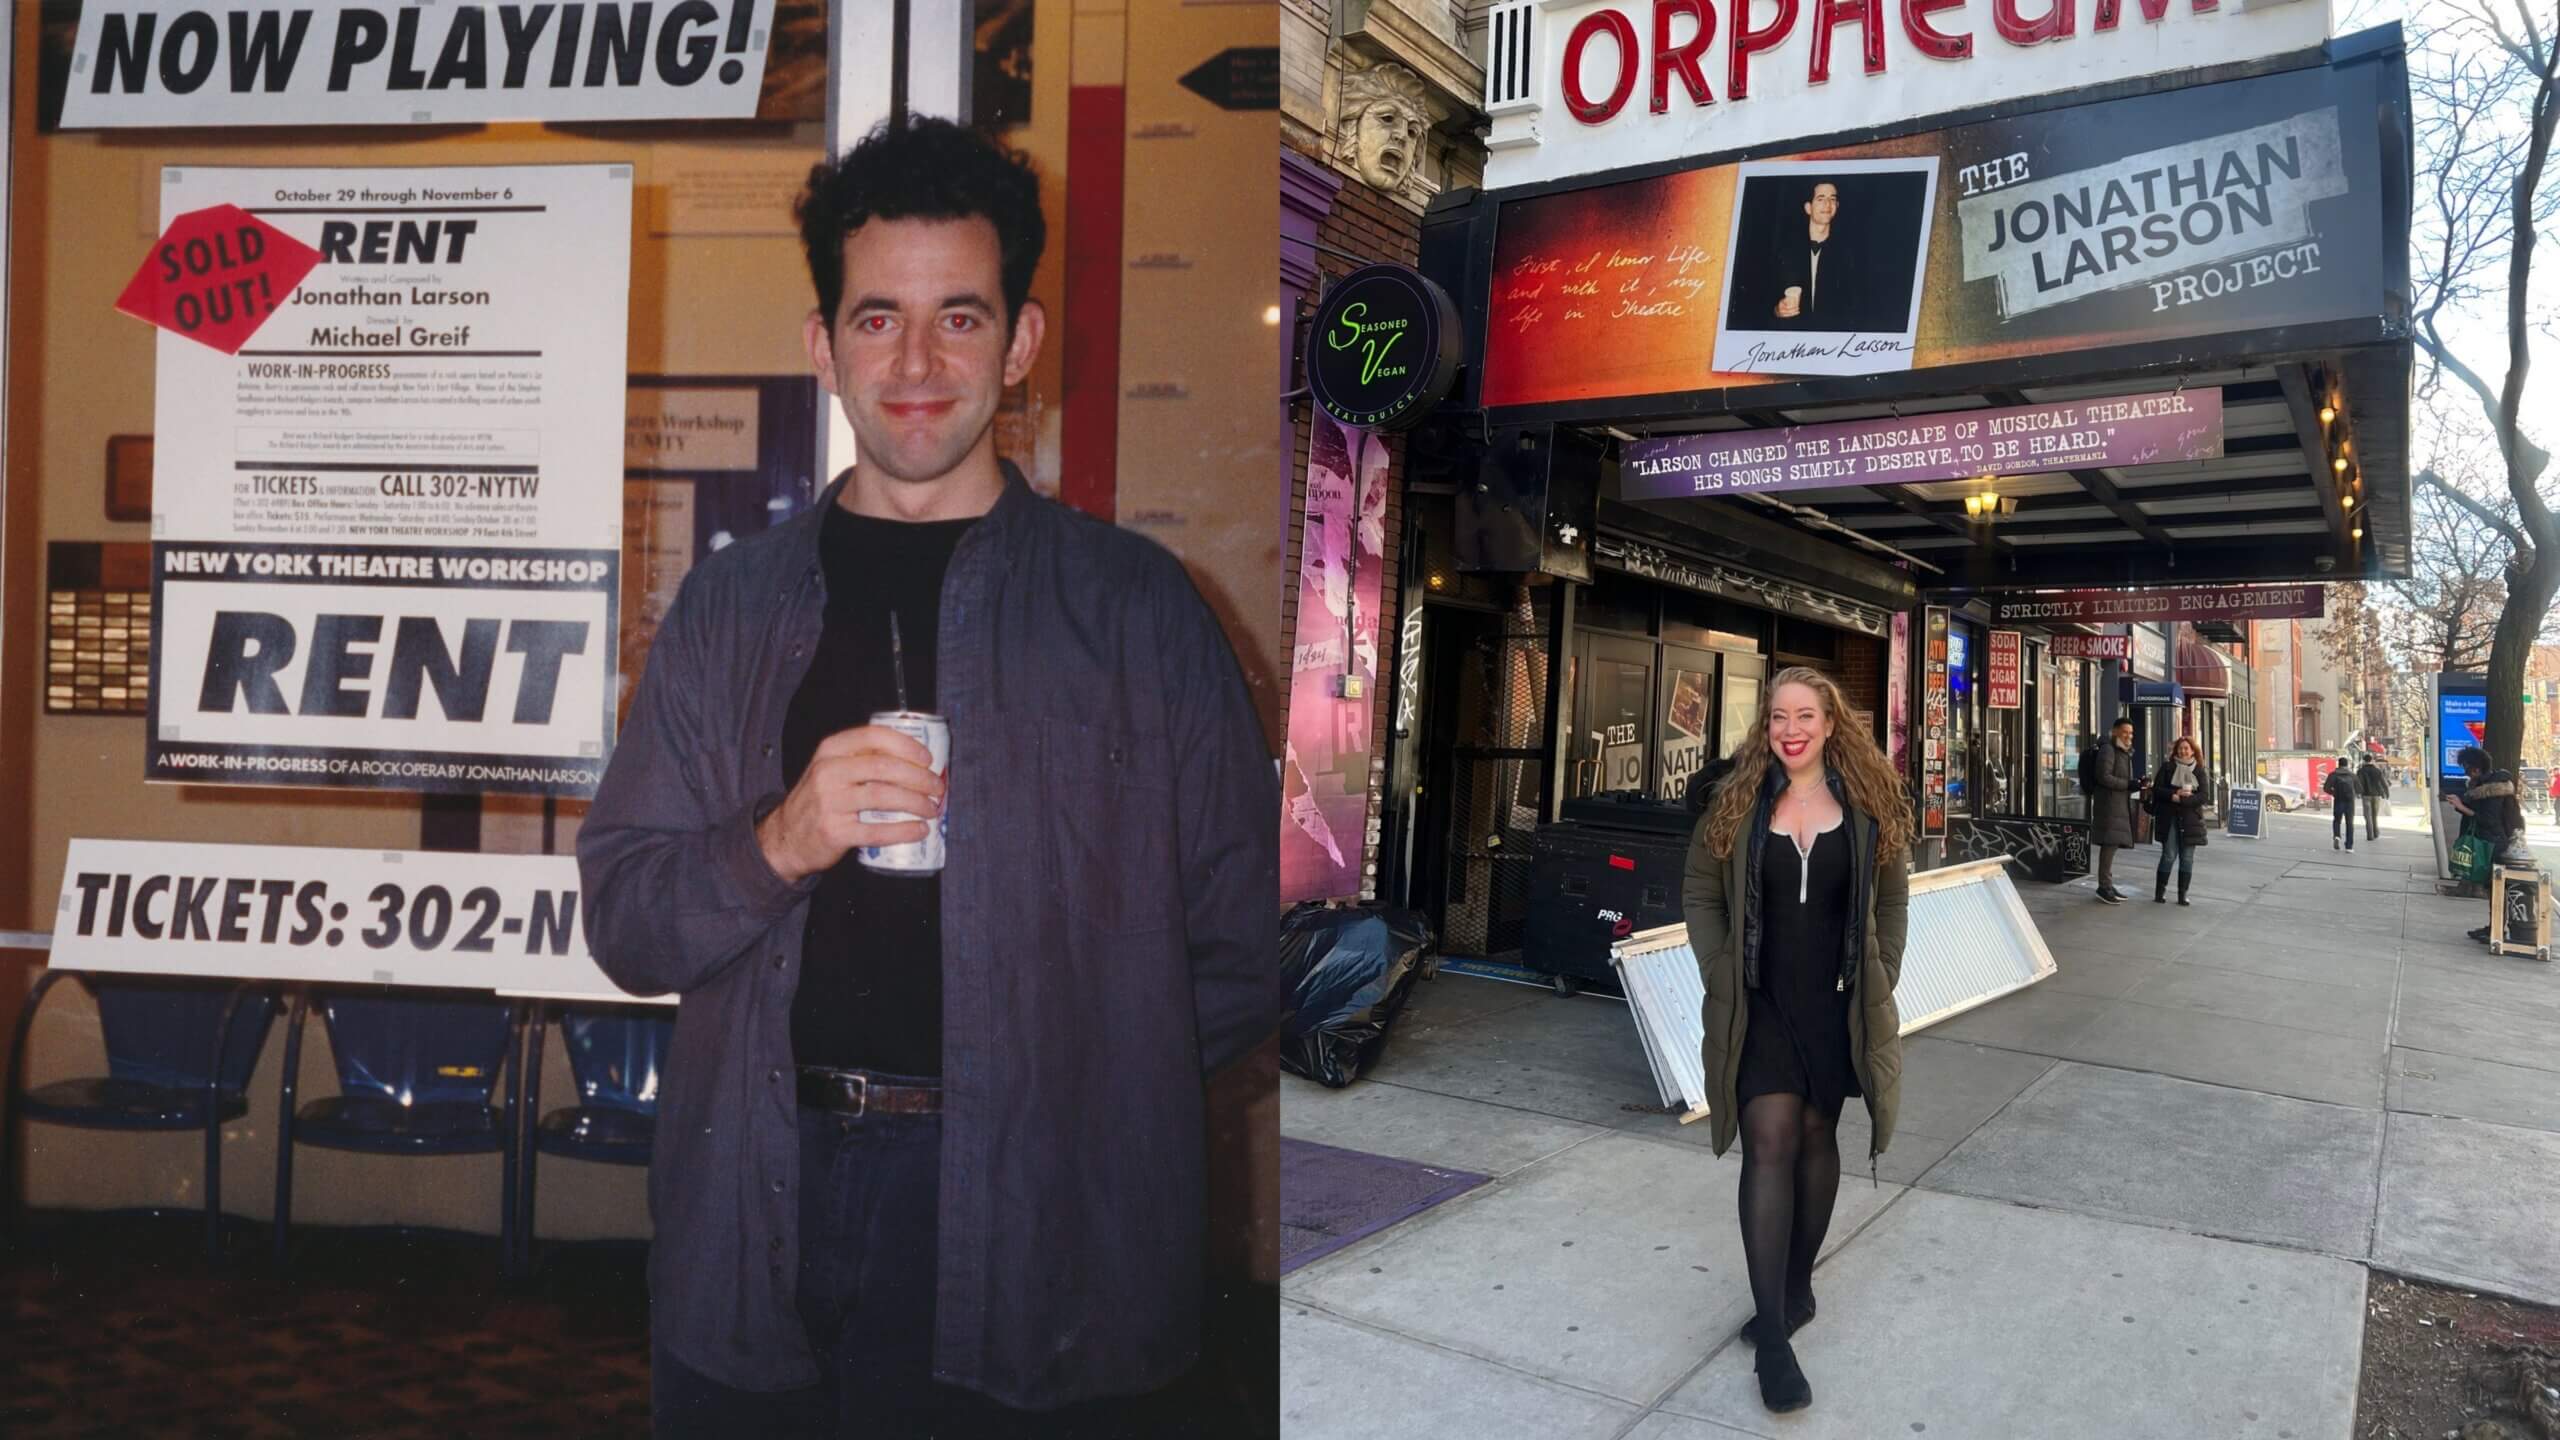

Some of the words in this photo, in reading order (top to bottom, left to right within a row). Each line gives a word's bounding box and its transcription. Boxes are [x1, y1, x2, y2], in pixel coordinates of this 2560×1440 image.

[91, 10, 311, 94] NOW
[327, 0, 753, 92] PLAYING!
[1959, 151, 2030, 196] THE
[274, 187, 332, 203] October
[337, 188, 356, 202] 29
[360, 187, 417, 205] through
[422, 187, 498, 200] November
[503, 187, 514, 200] 6
[1988, 136, 2301, 252] JONATHAN
[318, 220, 478, 264] RENT
[2032, 185, 2273, 292] LARSON
[159, 226, 265, 283] SOLD
[1606, 249, 1656, 268] honor
[1507, 283, 1544, 301] and
[1561, 279, 1600, 295] with
[1667, 279, 1706, 300] my
[2150, 243, 2321, 312] PROJECT
[175, 272, 275, 331] OUT!
[291, 286, 402, 305] Jonathan
[411, 287, 490, 305] Larson
[1509, 304, 1543, 334] life
[1564, 303, 1585, 321] in
[310, 328, 401, 347] Michael
[410, 326, 471, 347] Greif
[1728, 341, 1840, 376] Jonathan
[1837, 333, 1916, 358] Larson
[248, 363, 391, 379] WORK-IN-PROGRESS
[1367, 393, 1413, 423] QUICK
[1632, 454, 1702, 476] "LARSON
[1708, 444, 1787, 467] CHANGED
[1795, 438, 1831, 459] THE
[1837, 426, 1947, 454] LANDSCAPE
[1954, 422, 1979, 440] OF
[1988, 410, 2078, 436] MUSICAL
[2086, 396, 2194, 424] THEATER.
[1694, 473, 1724, 490] HIS
[1730, 467, 1783, 485] SONGS
[1789, 458, 1857, 481] SIMPLY
[1864, 448, 1952, 473] DESERVE
[1960, 445, 1984, 462] TO
[1992, 440, 2020, 459] BE
[2030, 428, 2116, 455] HEARD."
[1976, 462, 2003, 473] DAVID
[253, 475, 318, 495] TICKETS
[380, 475, 425, 497] CALL
[430, 475, 539, 499] 302-NYTW
[165, 551, 227, 573] NEW
[233, 552, 312, 576] YORK
[318, 555, 432, 579] THEATRE
[439, 557, 608, 583] WORKSHOP
[2001, 602, 2084, 619] STRICTLY
[2093, 598, 2170, 615] LIMITED
[2179, 589, 2305, 611] ENGAGEMENT
[1990, 632, 2016, 648] SODA
[2053, 637, 2079, 653] BEER
[2087, 637, 2124, 656] SMOKE
[198, 610, 590, 725] RENT
[1990, 652, 2016, 667] BEER
[1990, 671, 2016, 684] CIGAR
[1990, 688, 2016, 704] ATM
[1607, 723, 1636, 745] THE
[157, 753, 169, 766] A
[170, 753, 328, 773] WORK-IN-PROGRESS
[329, 759, 349, 773] OF
[349, 760, 360, 774] A
[361, 761, 400, 775] ROCK
[401, 762, 448, 777] OPERA
[449, 764, 465, 778] BY
[466, 765, 543, 781] JONATHAN
[544, 768, 600, 784] LARSON
[1617, 756, 1641, 785] JO
[76, 872, 347, 948] TICKETS:
[1597, 908, 1623, 923] PRG
